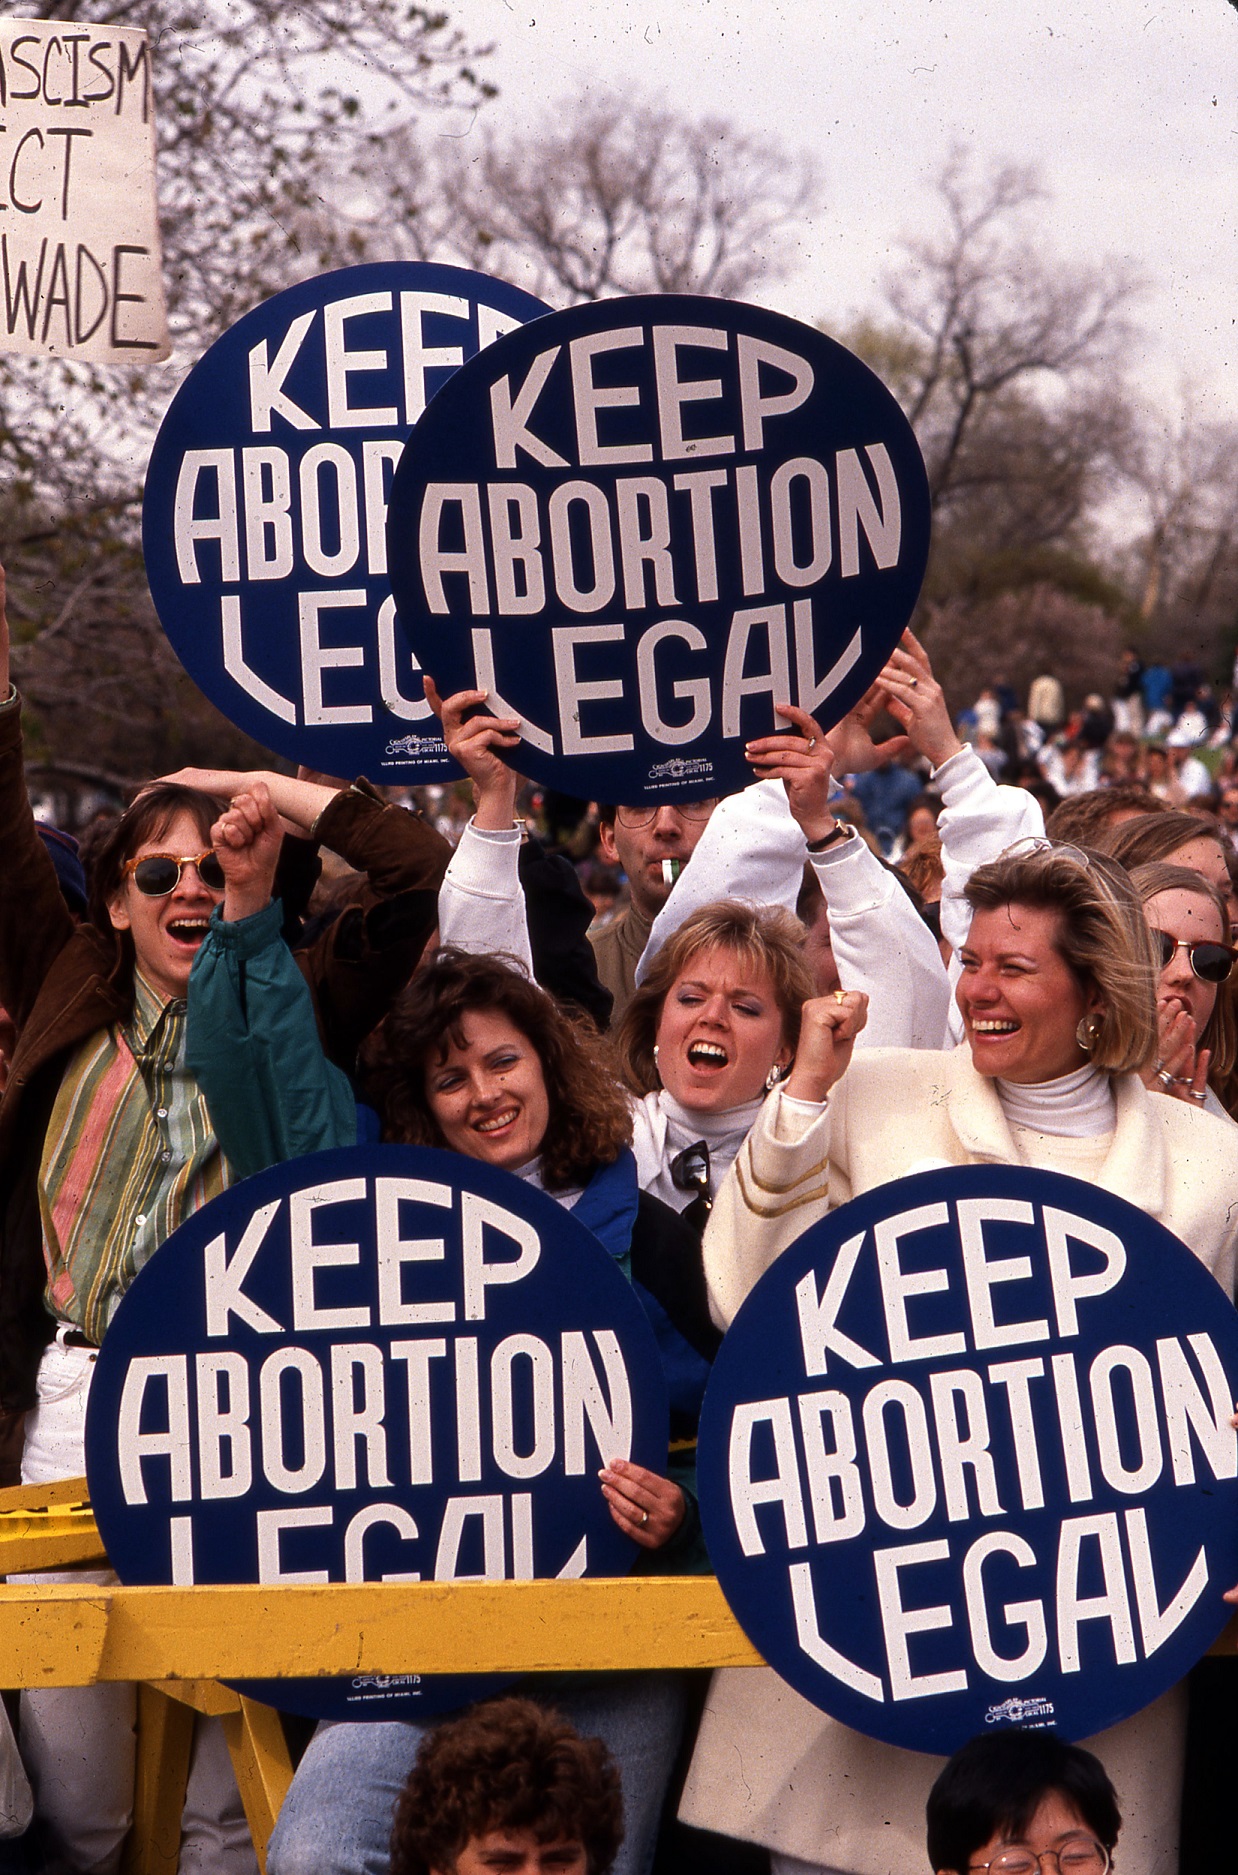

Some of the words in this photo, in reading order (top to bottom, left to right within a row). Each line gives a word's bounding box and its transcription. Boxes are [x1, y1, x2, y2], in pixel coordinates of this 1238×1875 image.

[0, 35, 149, 124] SCISM
[0, 125, 94, 221] CT
[1, 233, 160, 349] WADE
[490, 326, 814, 468] KEEP
[419, 443, 901, 614] ABORTION
[435, 743, 448, 753] 1175
[472, 599, 861, 755] LEGAL
[700, 762, 713, 773] 1175
[205, 1177, 541, 1336] KEEP
[796, 1198, 1126, 1377] KEEP
[118, 1330, 632, 1505] ABORTION
[729, 1332, 1238, 1556] ABORTION
[789, 1508, 1208, 1702] LEGAL
[1039, 1703, 1054, 1715] 1175
